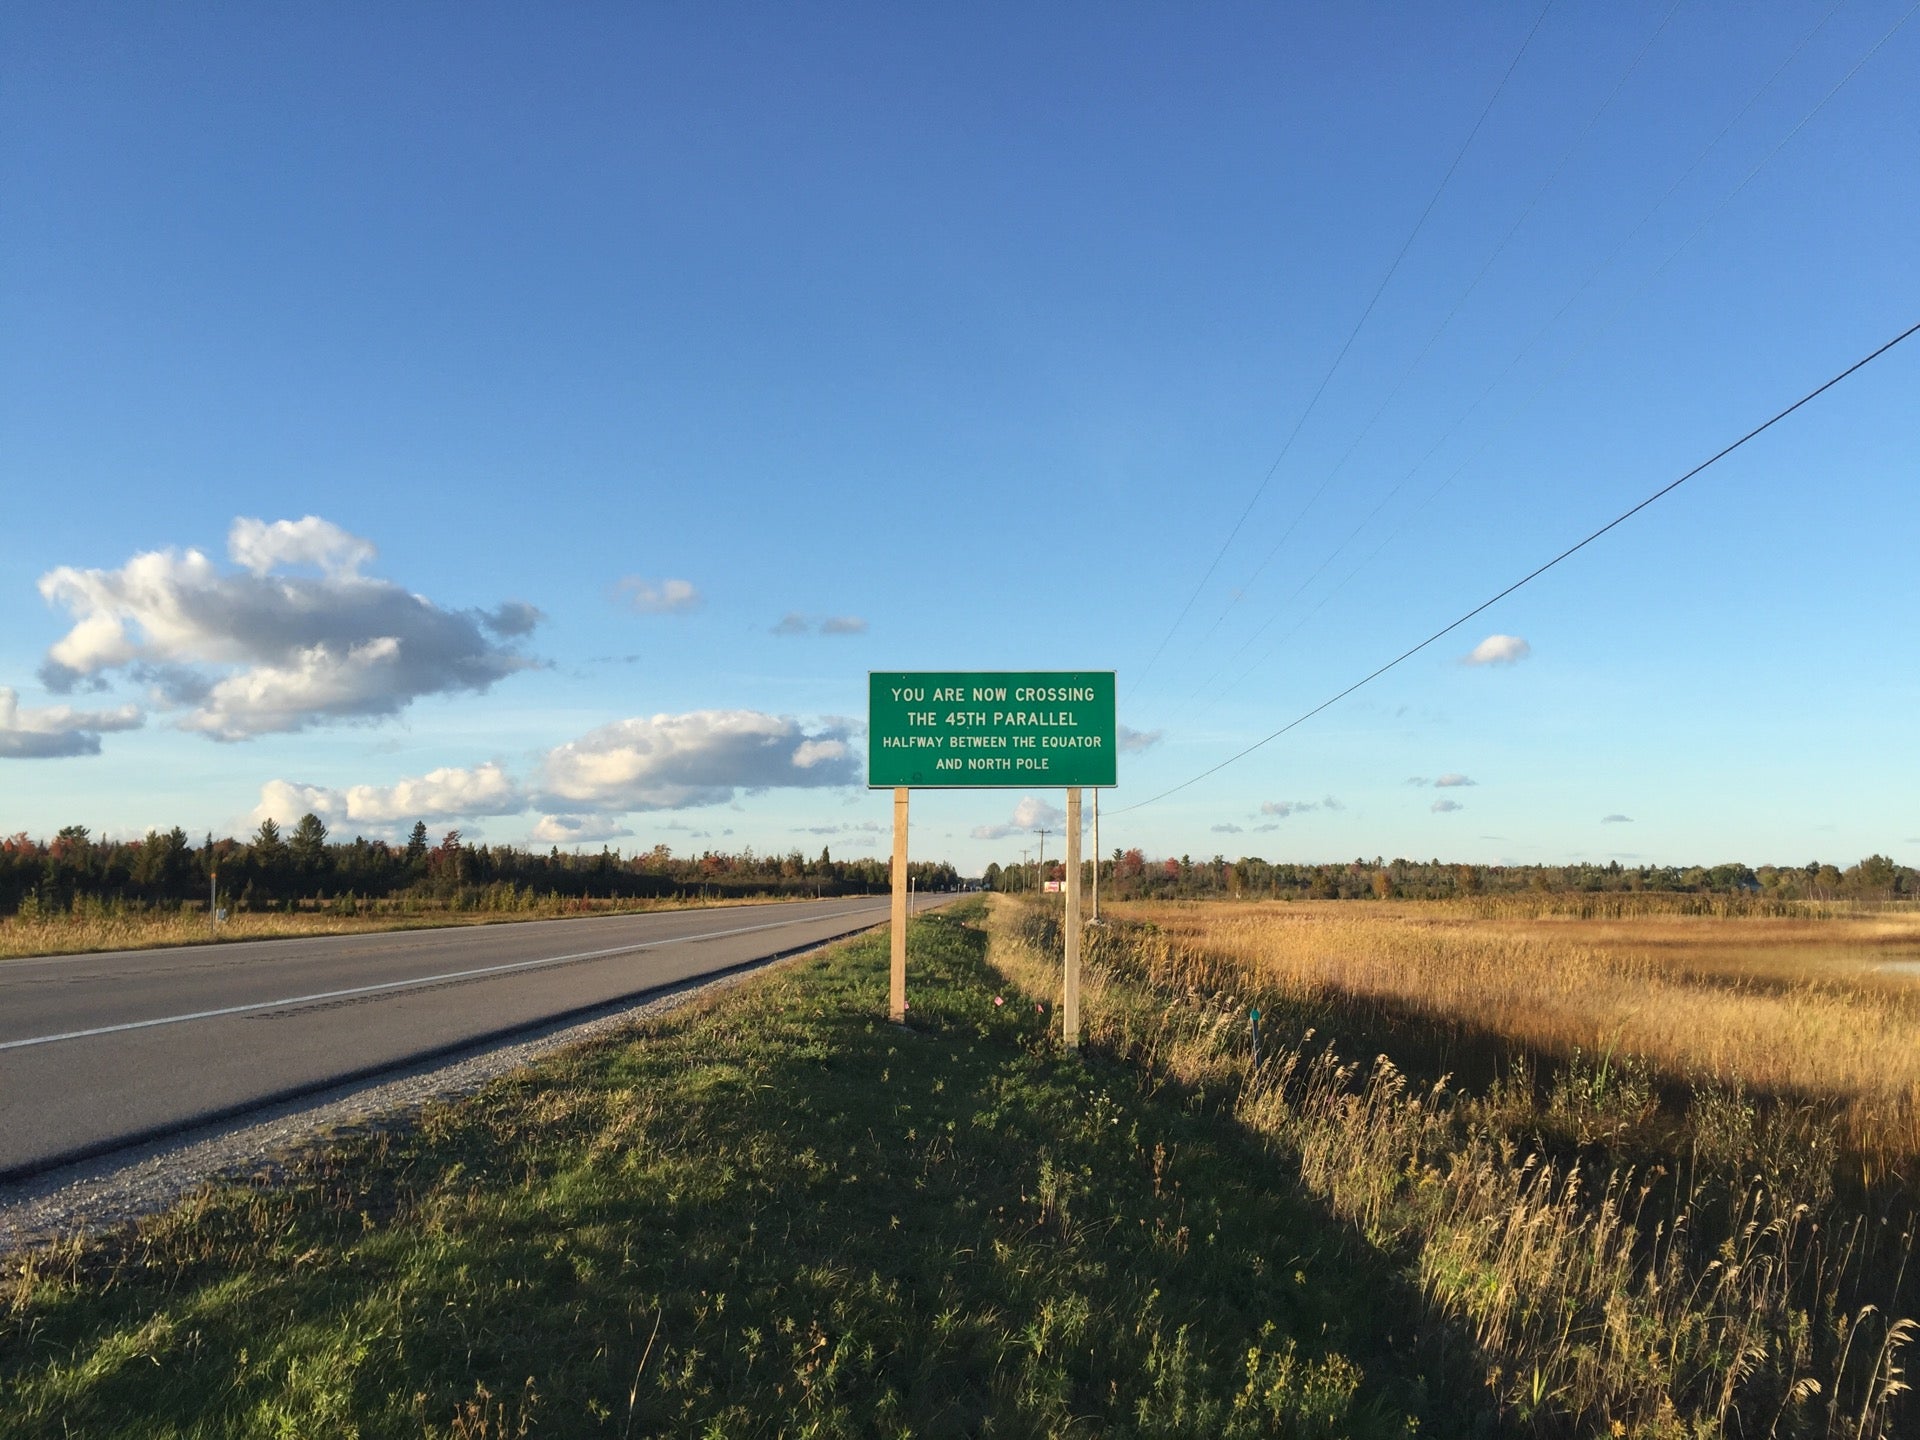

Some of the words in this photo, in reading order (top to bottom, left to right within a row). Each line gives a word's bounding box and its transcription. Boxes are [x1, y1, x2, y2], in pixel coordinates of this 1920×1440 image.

[891, 688, 923, 702] YOU
[932, 688, 964, 702] ARE
[973, 688, 1006, 702] NOW
[1015, 688, 1095, 702] CROSSING
[907, 712, 936, 726] THE
[945, 712, 985, 726] 45TH
[993, 712, 1077, 726] PARALLEL
[883, 736, 943, 748] HALFWAY
[950, 736, 1006, 748] BETWEEN
[1012, 736, 1035, 748] THE
[1042, 736, 1102, 748] EQUATOR
[936, 758, 962, 770] AND
[968, 758, 1010, 770] NORTH
[1016, 758, 1049, 770] POLE
